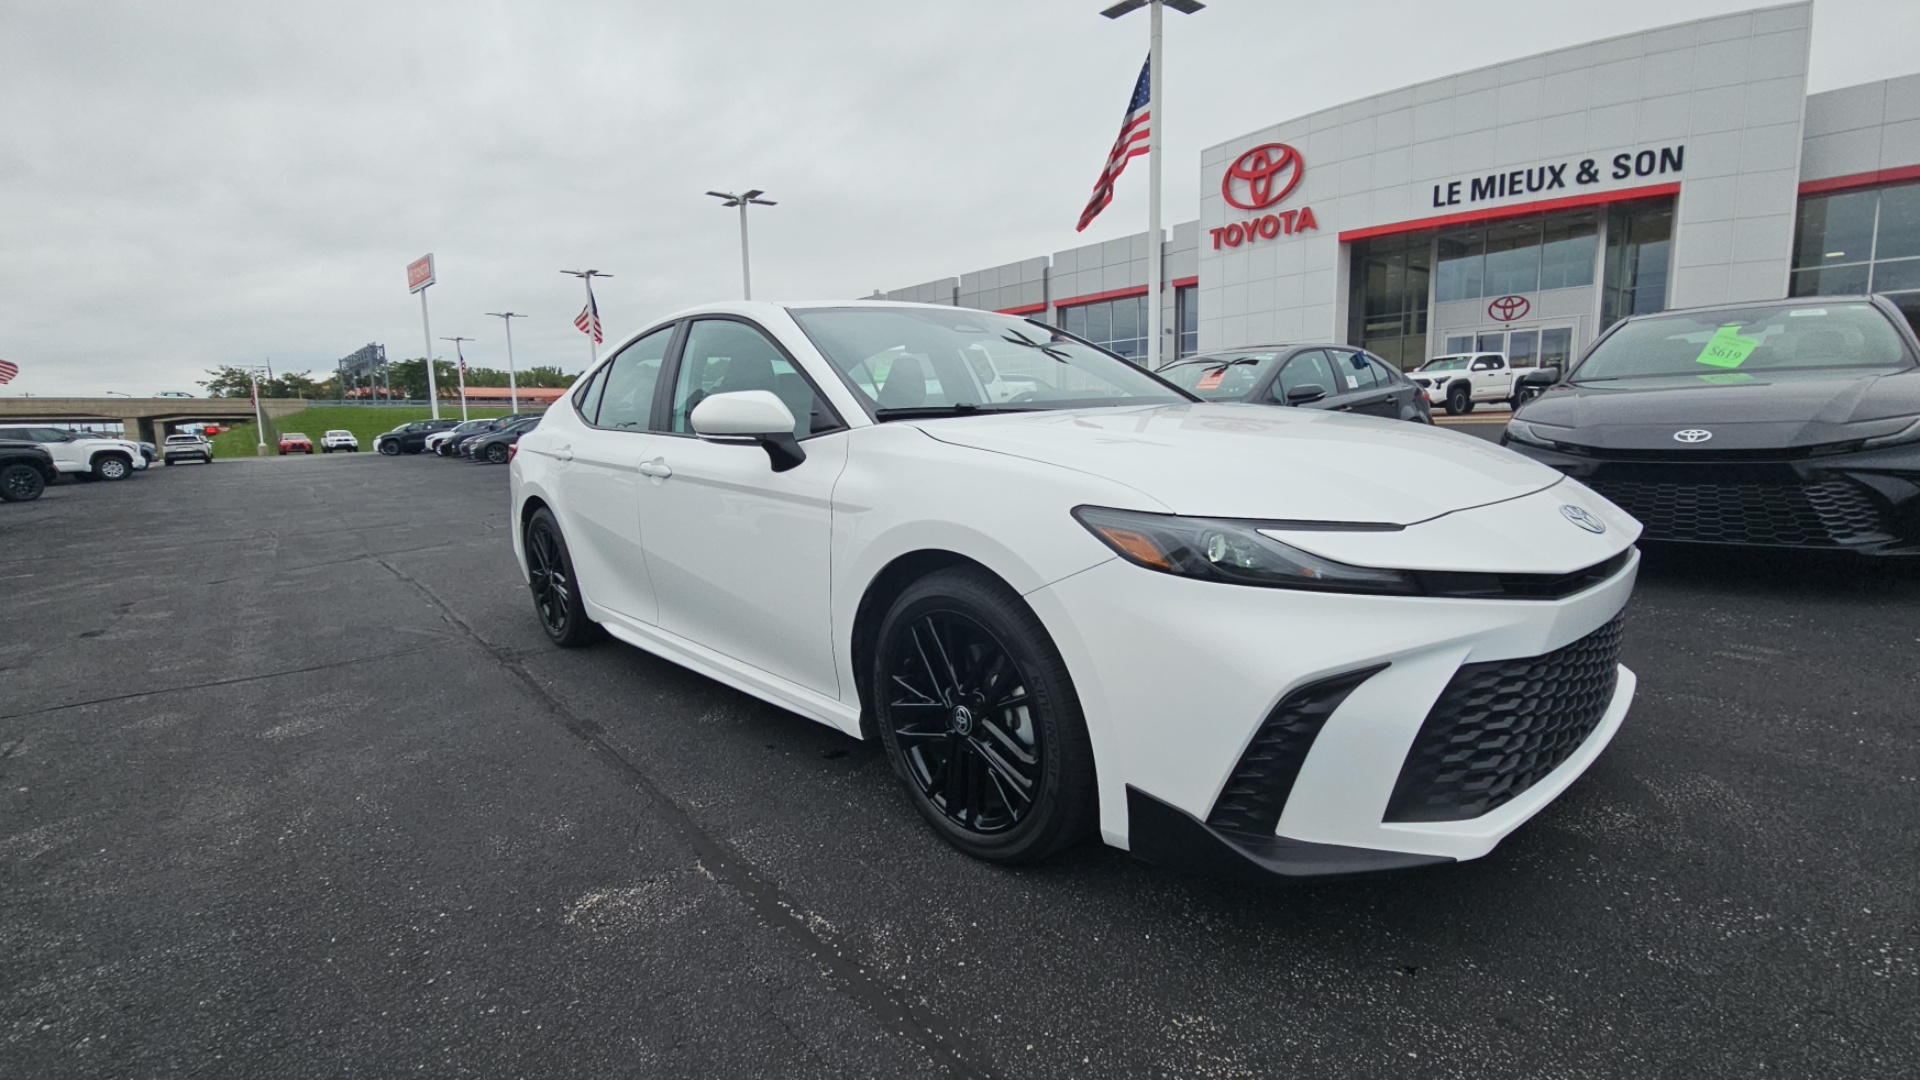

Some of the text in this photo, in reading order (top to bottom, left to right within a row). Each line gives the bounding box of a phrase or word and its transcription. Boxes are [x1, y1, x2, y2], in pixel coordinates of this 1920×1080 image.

[1433, 145, 1686, 207] LE MIEUX & SON
[1210, 206, 1318, 250] TOYOTA
